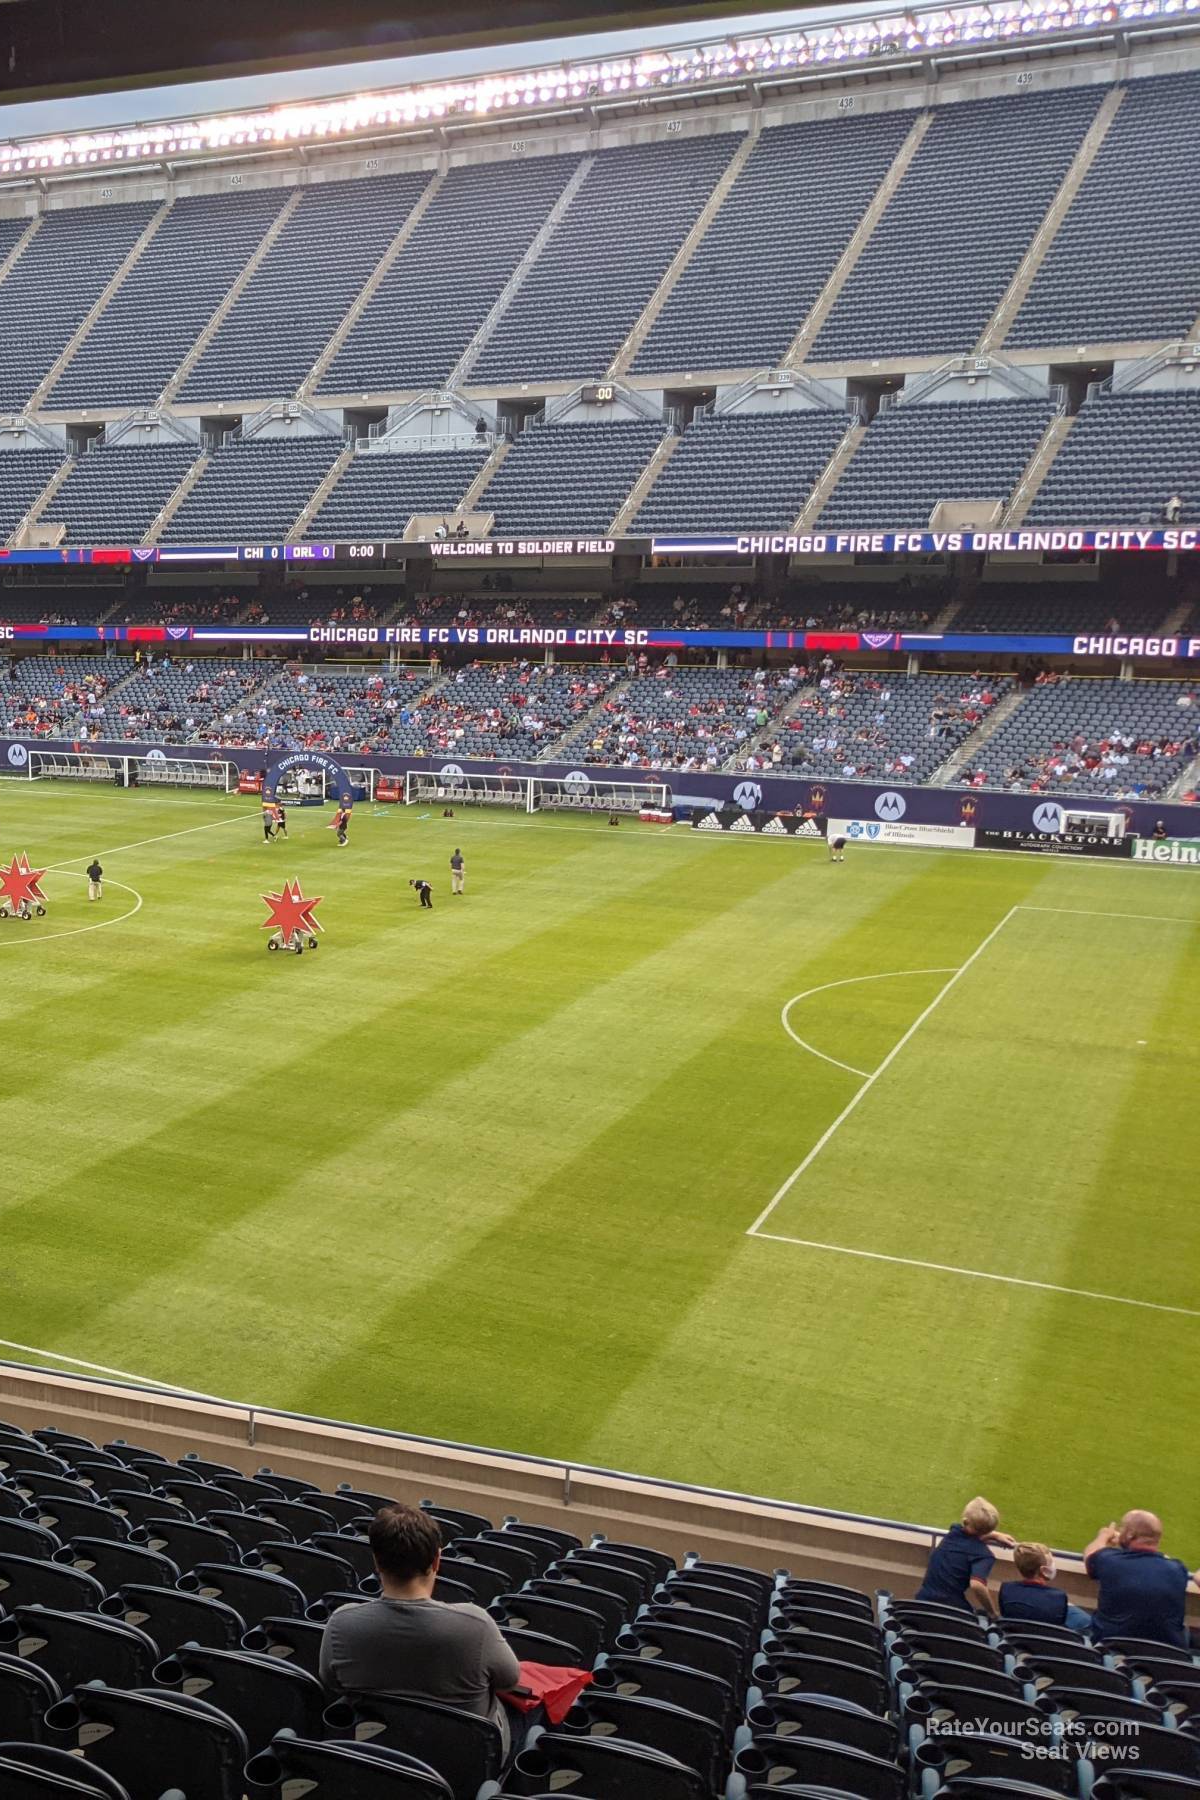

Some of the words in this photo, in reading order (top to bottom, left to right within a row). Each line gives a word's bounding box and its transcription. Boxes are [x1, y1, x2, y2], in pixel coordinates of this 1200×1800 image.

[1017, 73, 1032, 84] 439
[666, 121, 681, 132] 437
[431, 543, 492, 555] WELCOME
[497, 542, 514, 554] TO
[518, 541, 572, 554] SOLDIER
[577, 540, 615, 553] FIELD
[737, 535, 825, 553] CHICAGO
[836, 535, 882, 552] FIRE
[894, 534, 921, 551] FC
[932, 533, 962, 551] VS
[972, 533, 1082, 550] ORLANDO
[1094, 531, 1147, 549] CITY
[1163, 531, 1196, 548] SC
[244, 547, 264, 559] CHI
[272, 547, 279, 559] 0
[293, 547, 315, 559] ORL
[323, 547, 330, 559] 0
[349, 546, 374, 558] 0:00
[310, 627, 378, 643] CHICAGO
[386, 628, 421, 643] FIRE
[428, 628, 449, 643] FC
[456, 629, 479, 643] VS
[486, 629, 567, 644] ORLANDO
[574, 630, 616, 645] CITY
[624, 630, 648, 646] SC
[1073, 637, 1178, 656] CHICAGO
[278, 754, 310, 771] CHICAGO
[311, 756, 329, 766] FIRE
[327, 765, 339, 775] FC
[729, 824, 755, 832] adidas
[761, 826, 787, 834] adidas
[795, 828, 821, 836] adidas
[885, 824, 917, 832] BlueCross
[919, 826, 954, 834] BlueShield
[1003, 830, 1123, 846] BLACKSTONE
